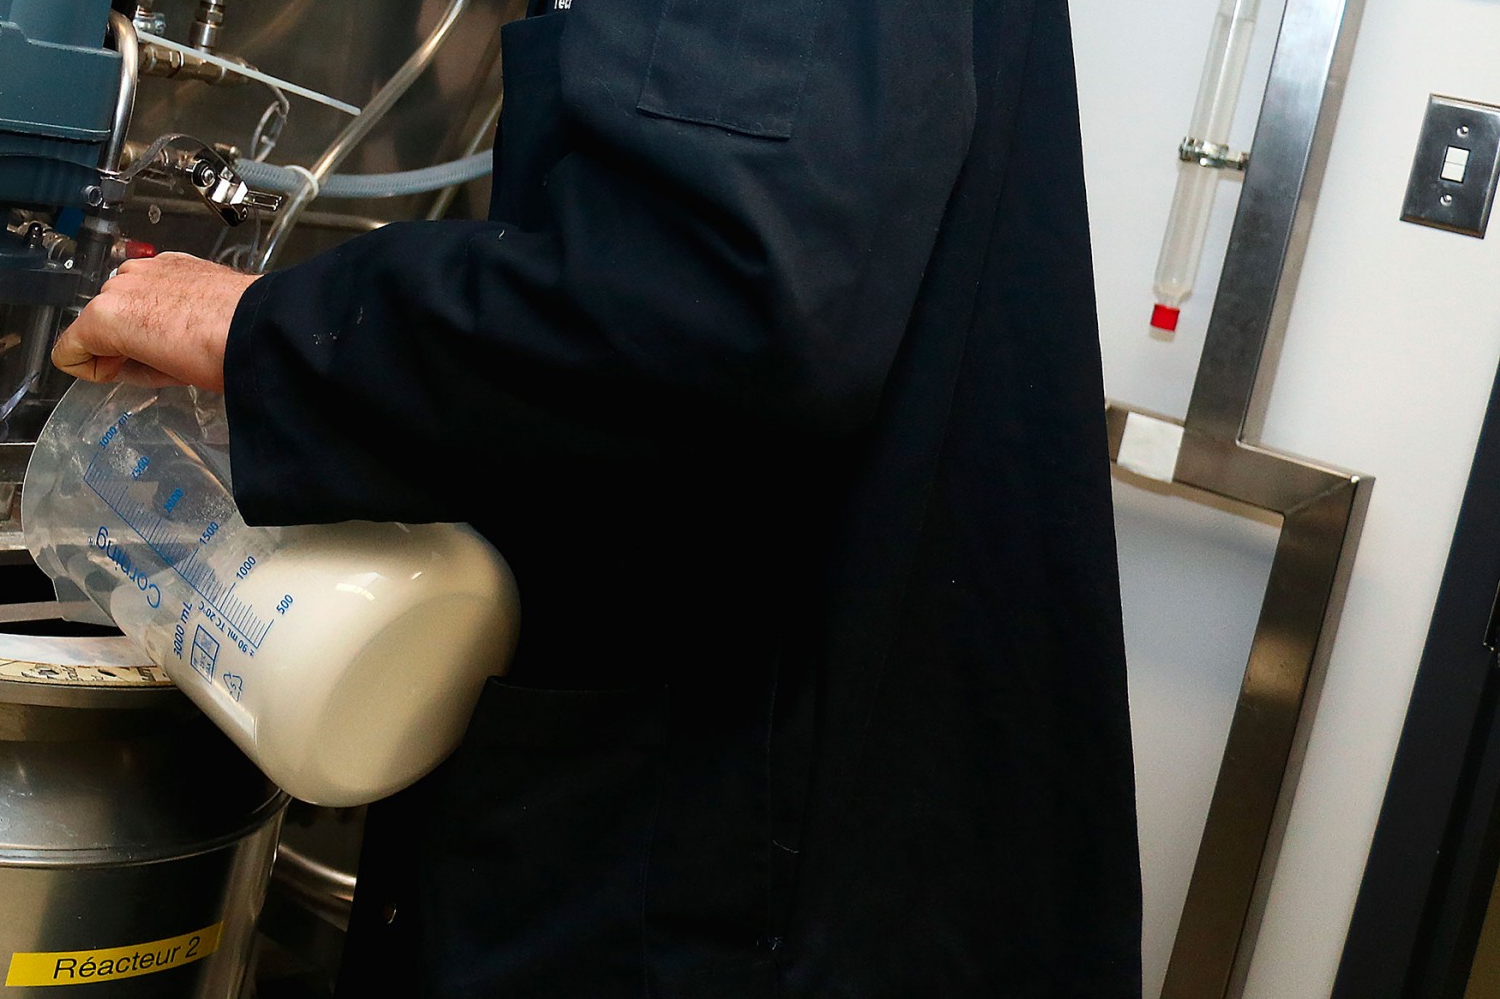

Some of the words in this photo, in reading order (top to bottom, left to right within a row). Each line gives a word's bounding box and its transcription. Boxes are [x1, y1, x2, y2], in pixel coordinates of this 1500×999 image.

[163, 486, 185, 514] 2000
[198, 520, 220, 546] 1500
[95, 526, 162, 609] Corning
[235, 555, 258, 581] 1000
[275, 593, 295, 617] 500
[173, 624, 186, 660] 3000
[180, 601, 193, 624] mL
[215, 618, 226, 633] TC
[227, 627, 239, 642] mL
[237, 639, 249, 653] 90
[53, 944, 182, 980] Réacteur
[185, 935, 201, 959] 2
